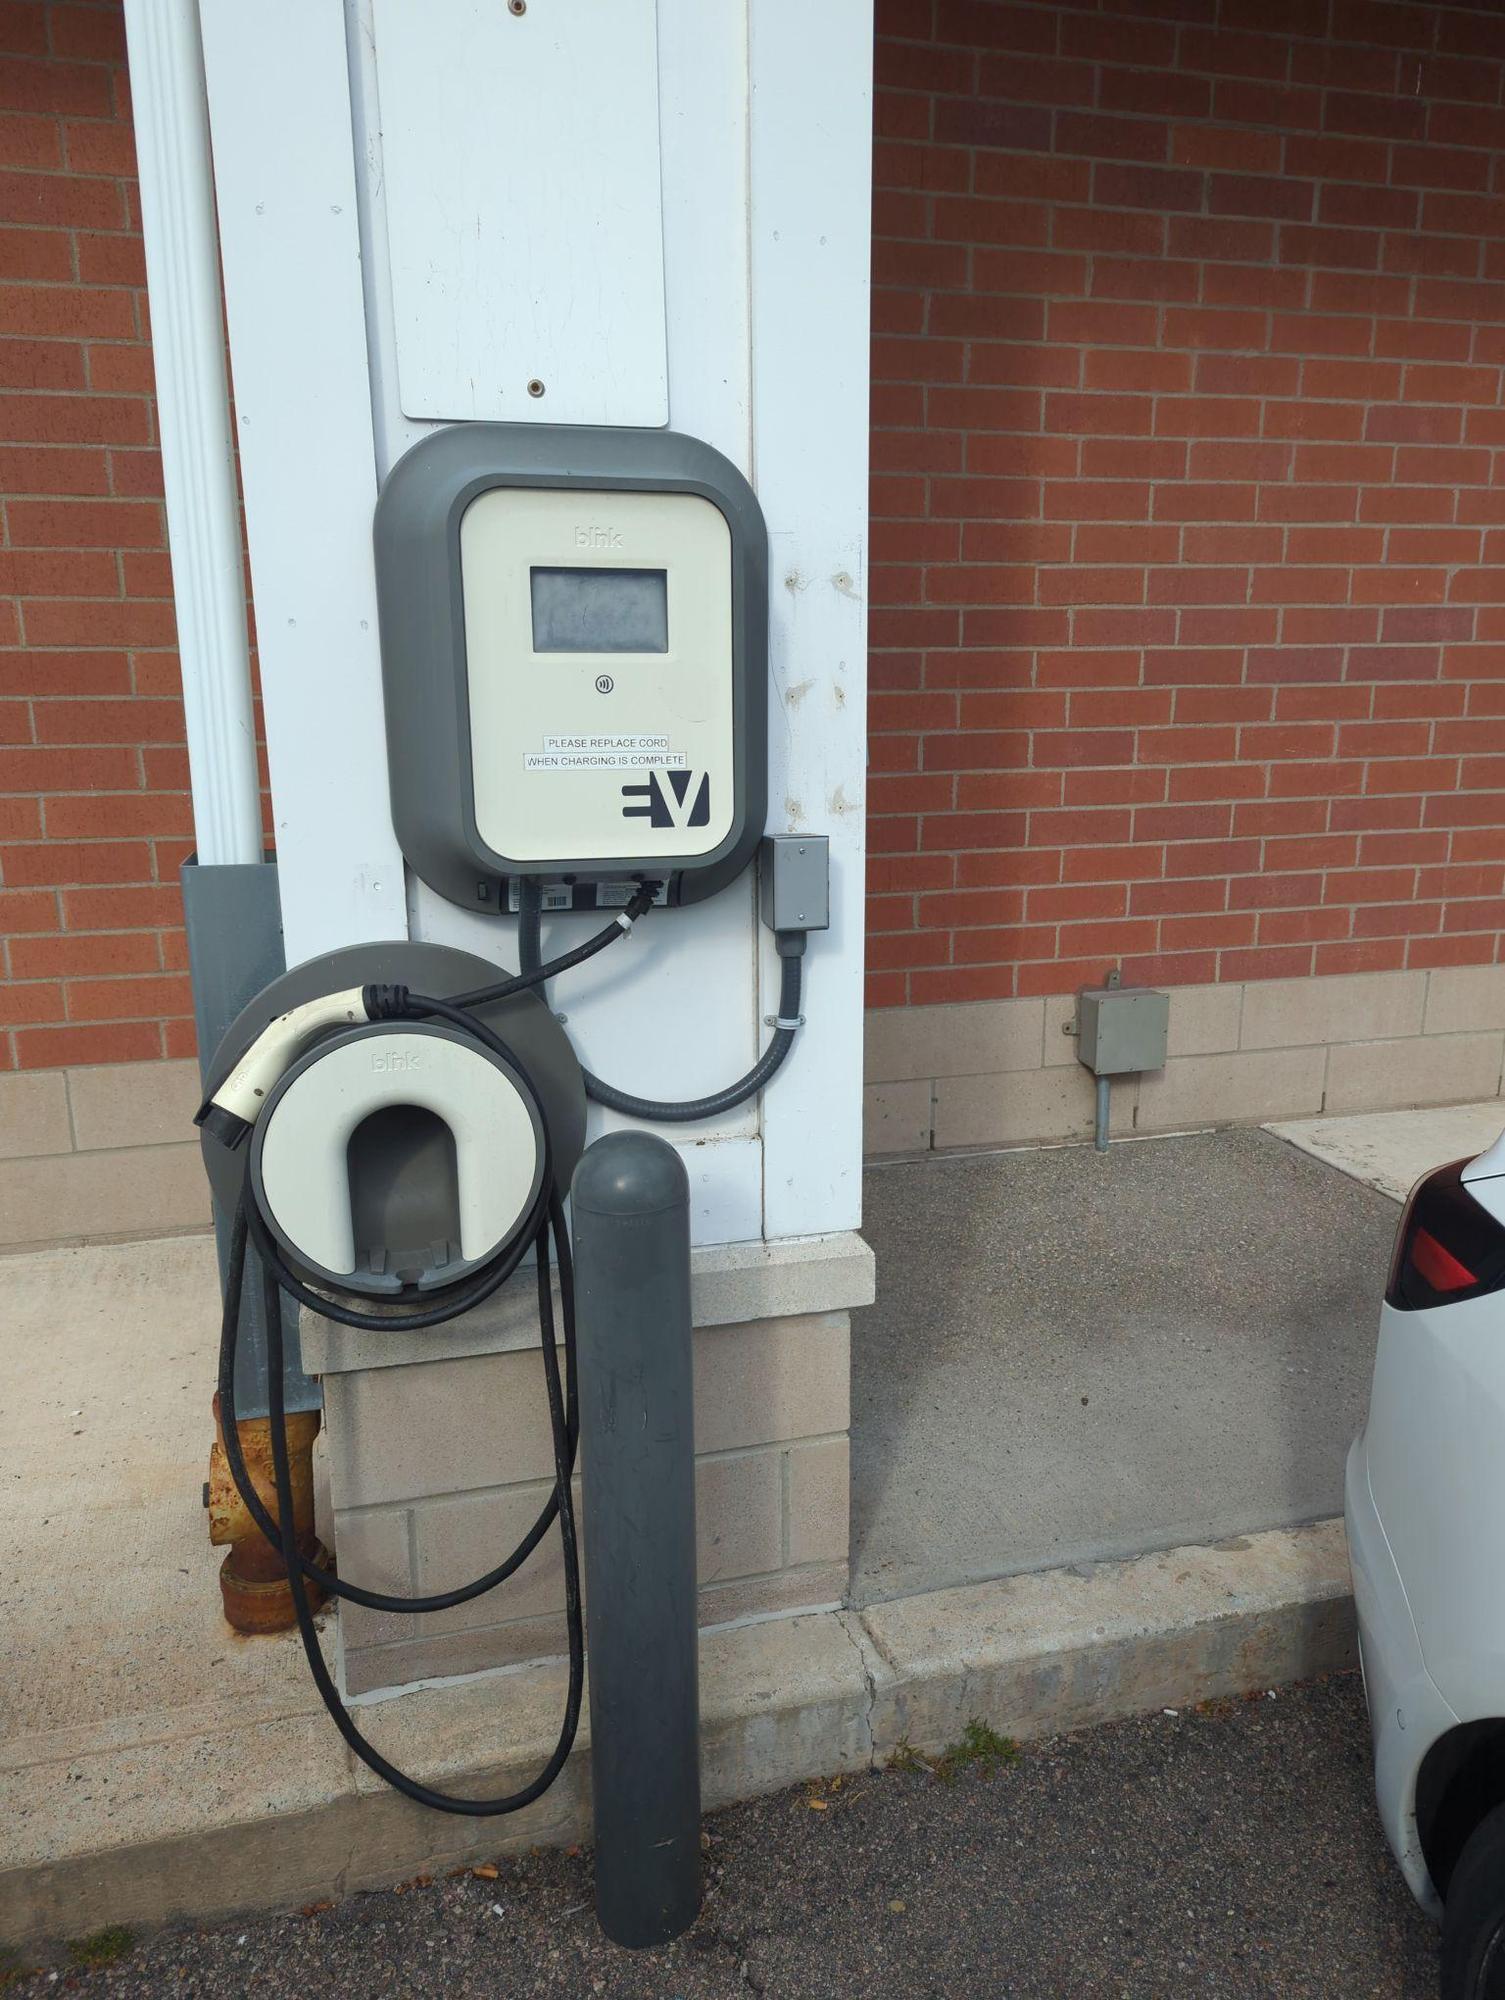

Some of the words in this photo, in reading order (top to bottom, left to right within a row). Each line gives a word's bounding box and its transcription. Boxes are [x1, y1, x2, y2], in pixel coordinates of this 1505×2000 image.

[573, 525, 624, 547] blink
[548, 738, 587, 749] PLEASE
[590, 738, 637, 749] REPLACE
[639, 738, 668, 749] CORD
[527, 756, 560, 767] WHEN
[561, 755, 616, 766] CHARGING
[618, 755, 628, 765] IS
[630, 754, 685, 765] COMPLETE
[621, 770, 711, 829] EV
[370, 1050, 423, 1073] blink
